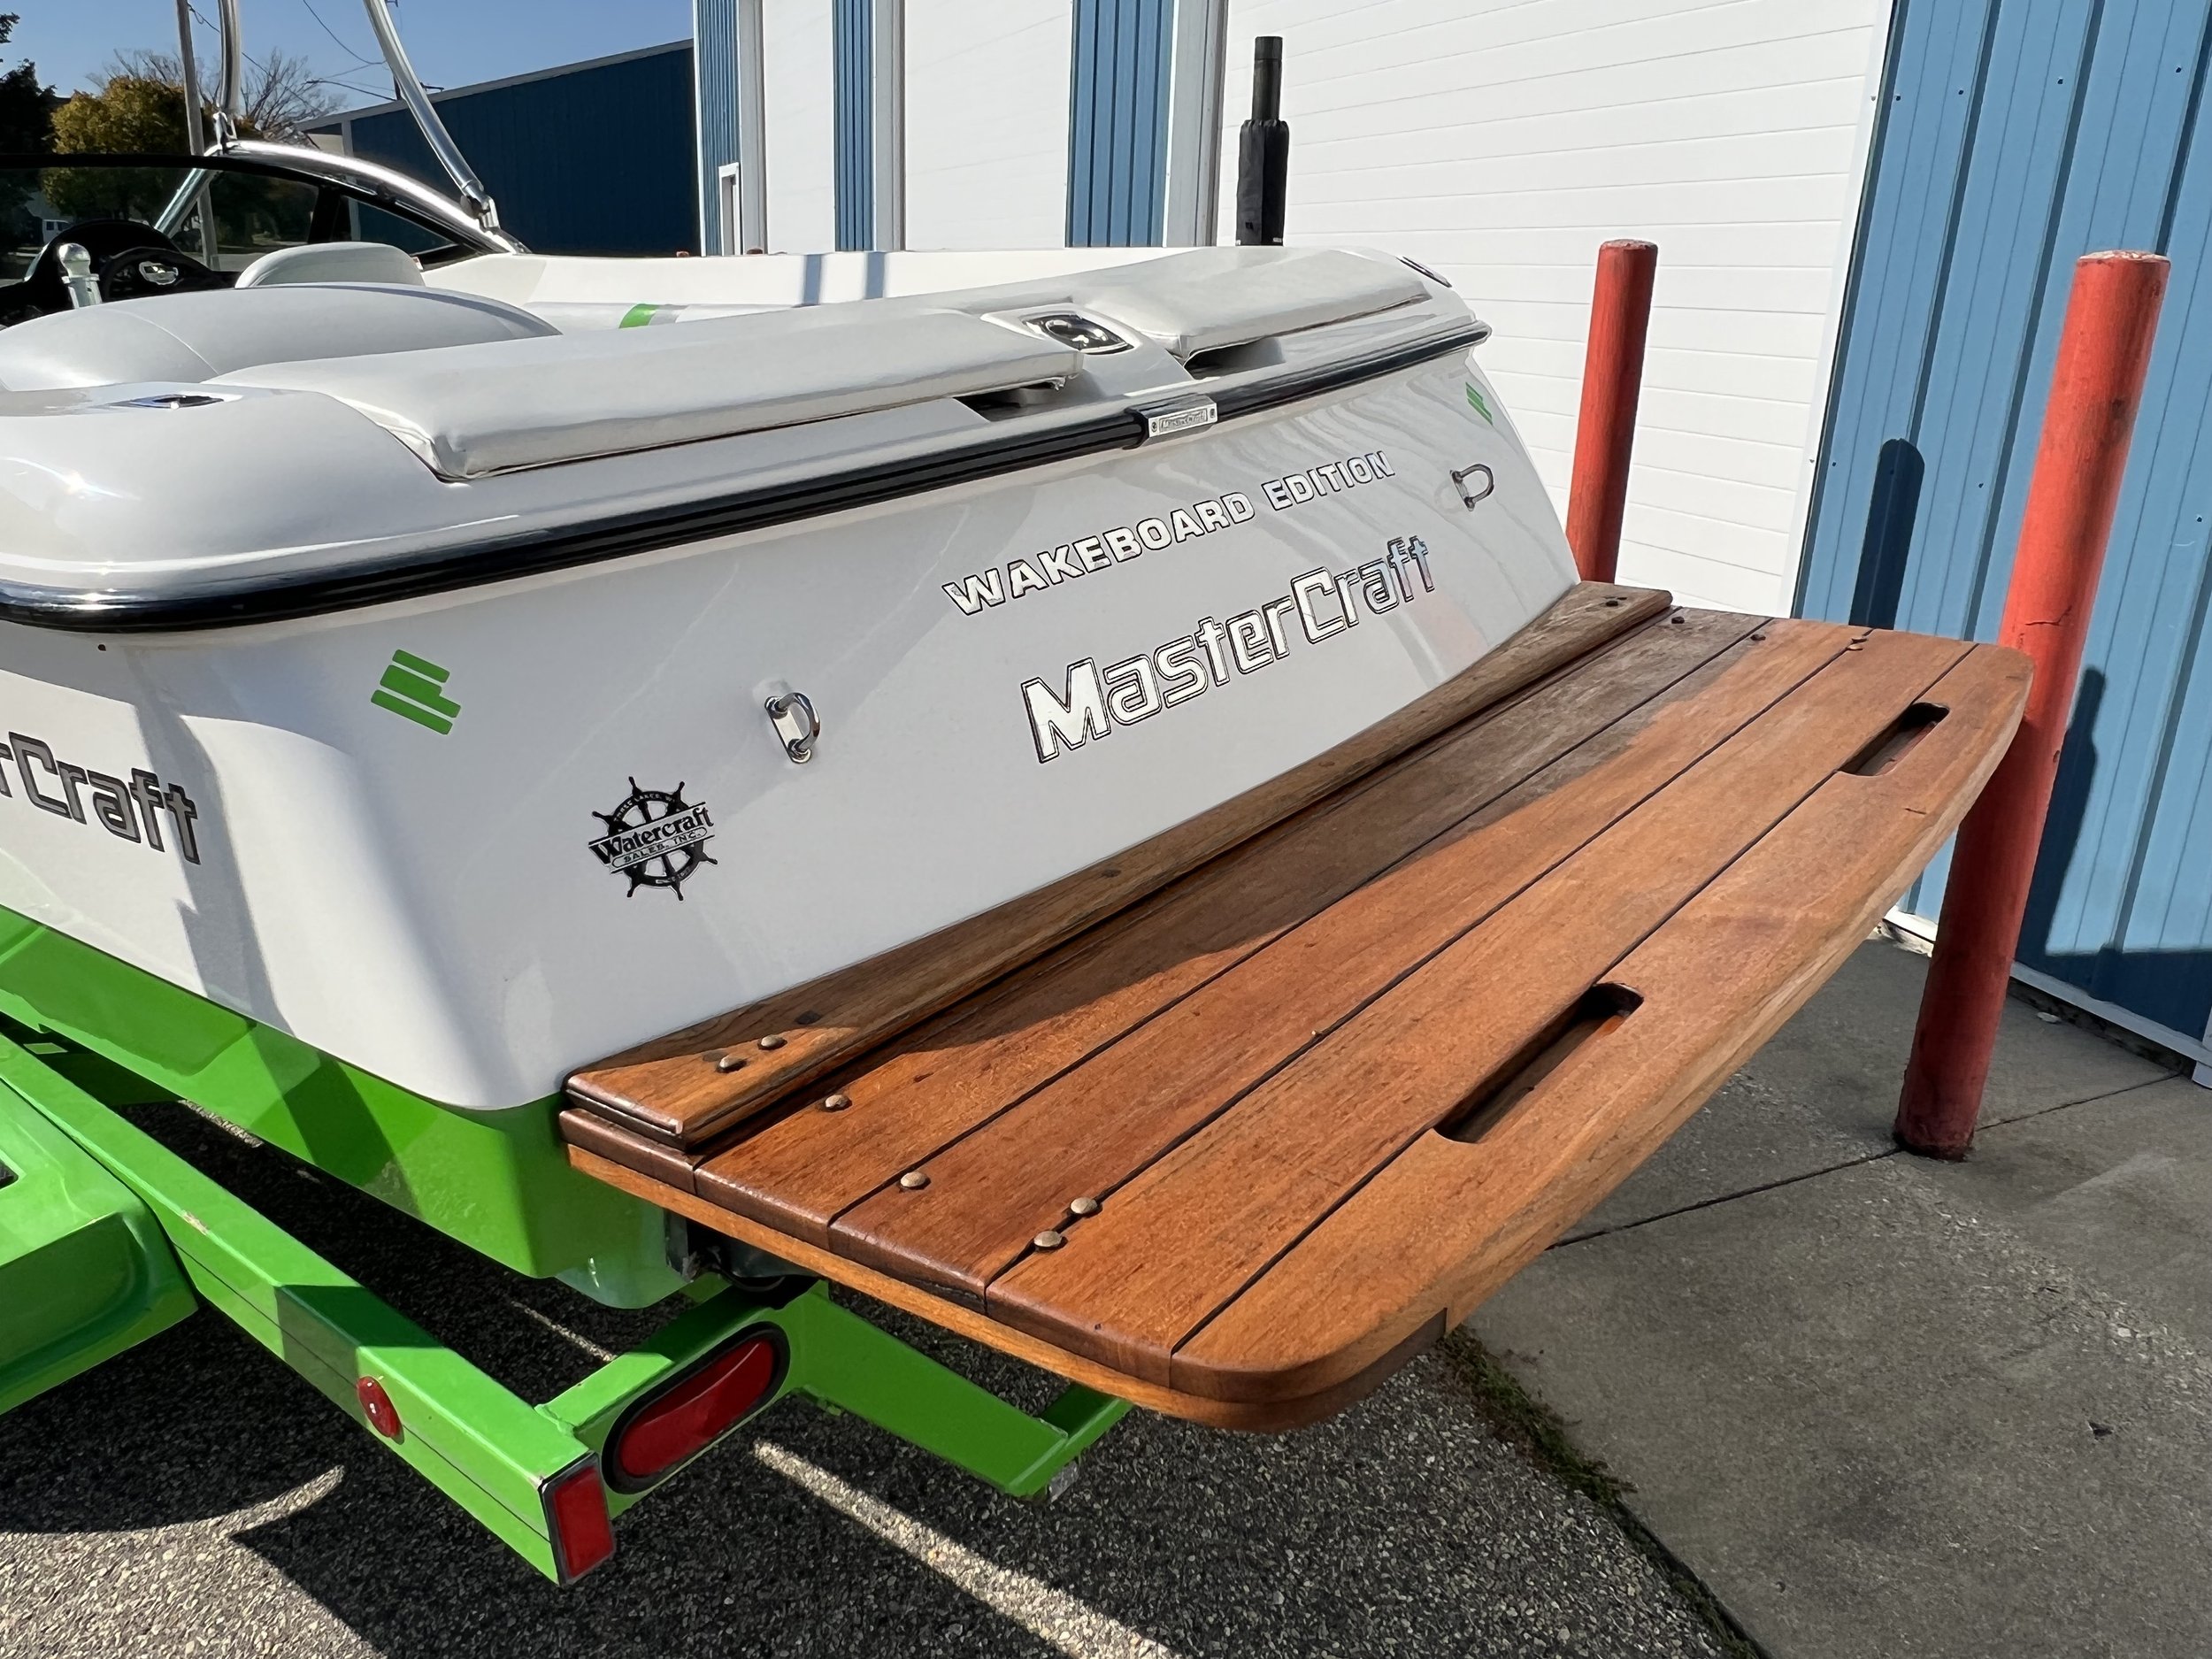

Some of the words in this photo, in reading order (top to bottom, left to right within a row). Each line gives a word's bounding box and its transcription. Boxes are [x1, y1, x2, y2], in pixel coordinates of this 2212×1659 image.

[942, 492, 1256, 616] WAKEBOARD
[1261, 450, 1395, 511] EDITION
[1020, 536, 1436, 764] MasterCraft
[588, 806, 714, 864] Watercraft
[672, 832, 702, 846] INC.
